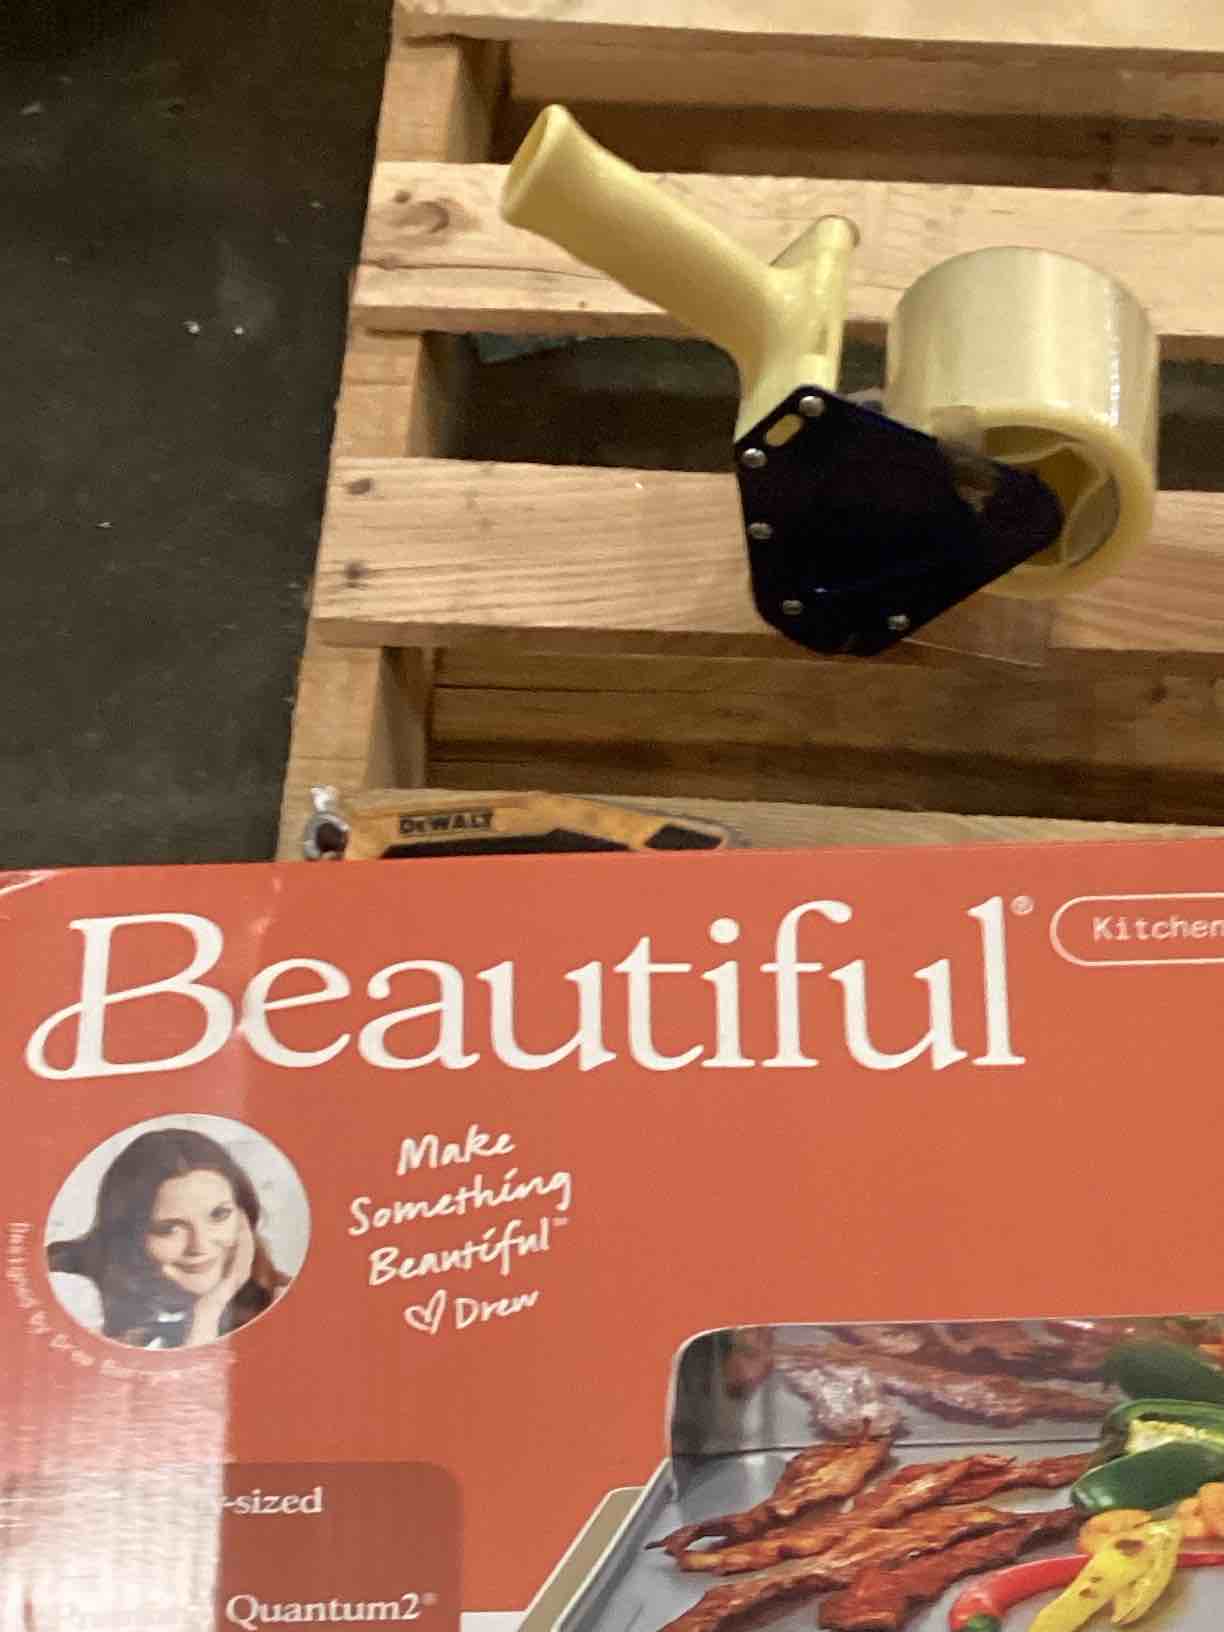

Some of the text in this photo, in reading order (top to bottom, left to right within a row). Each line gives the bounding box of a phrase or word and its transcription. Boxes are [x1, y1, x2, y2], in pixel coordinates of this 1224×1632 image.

[24, 895, 1027, 1080] Beautiful
[396, 1123, 516, 1176] Make
[348, 1167, 572, 1236] Something
[368, 1216, 550, 1286] Beautiful
[454, 1290, 540, 1329] Drew
